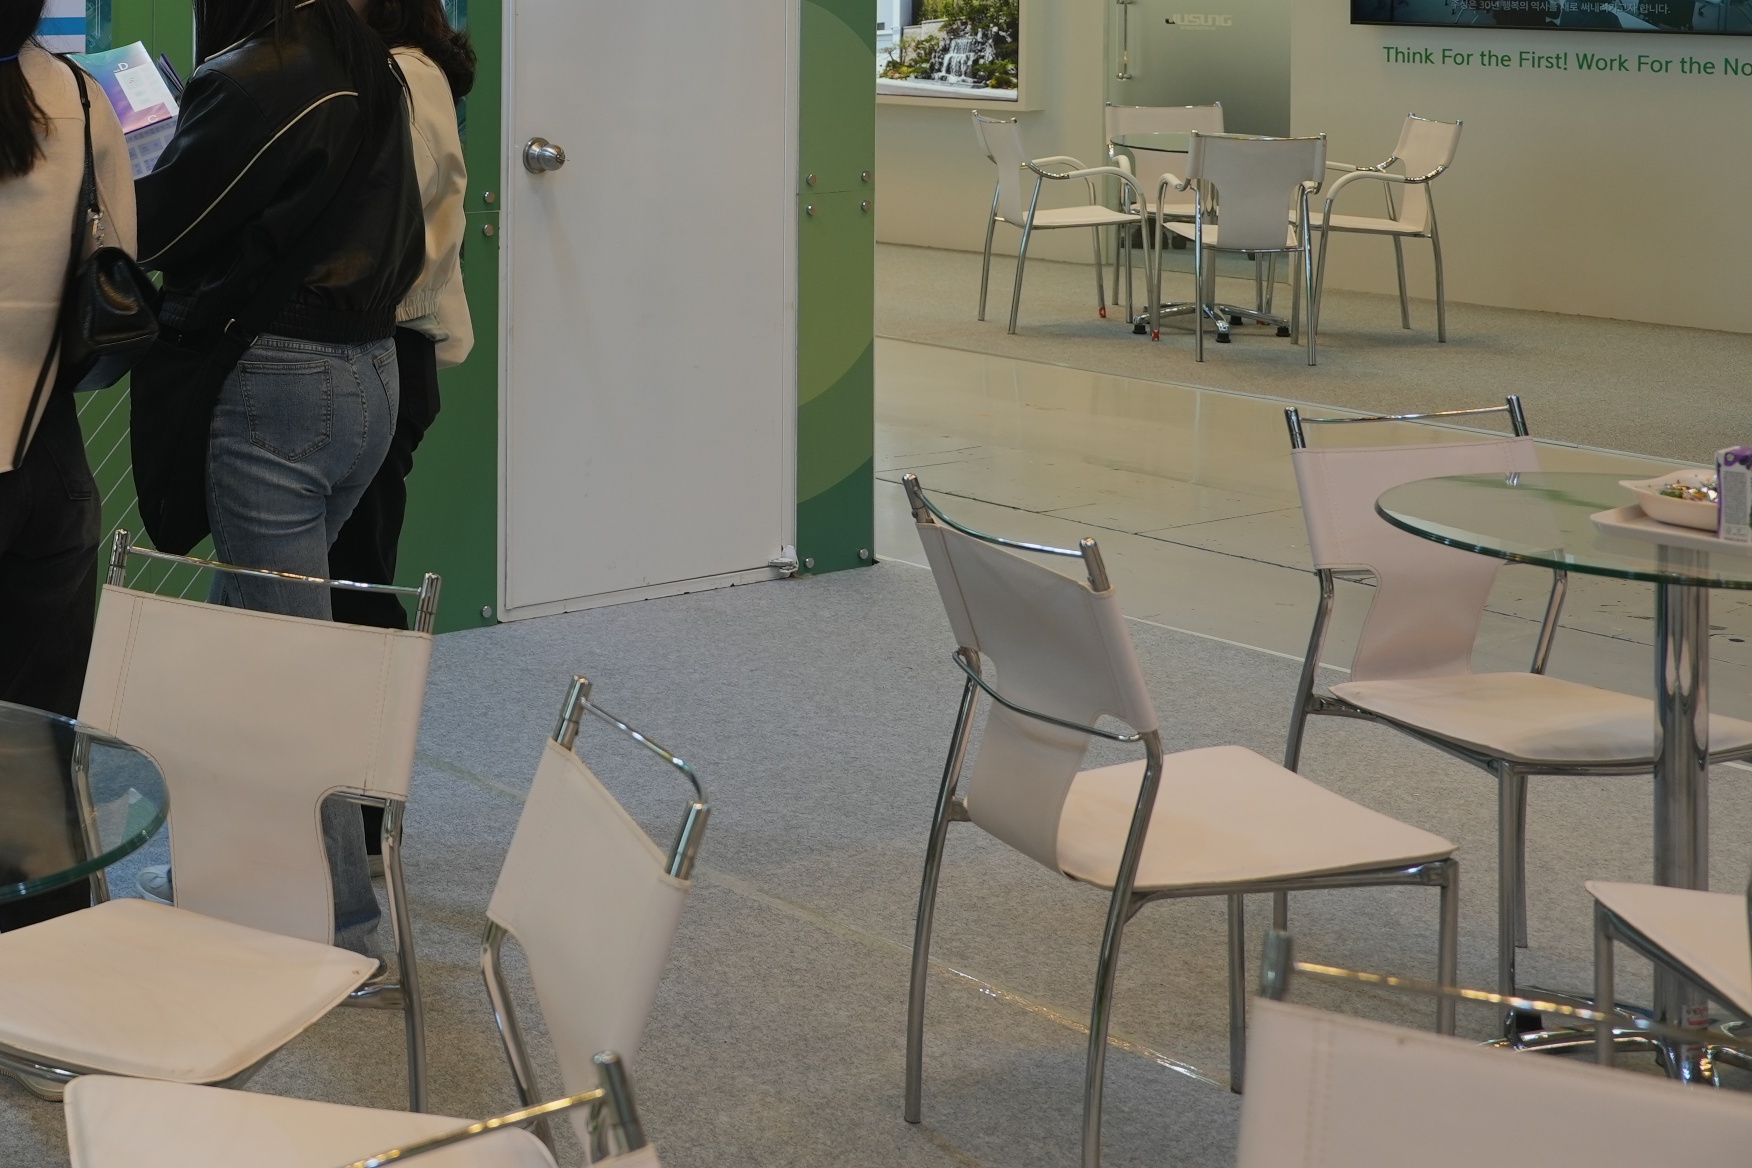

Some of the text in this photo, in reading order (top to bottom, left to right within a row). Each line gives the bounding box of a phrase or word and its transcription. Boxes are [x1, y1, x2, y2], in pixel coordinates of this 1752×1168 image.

[1451, 0, 1476, 10] 주성은
[1479, 0, 1500, 10] 30년
[1502, 0, 1528, 11] 행복의
[1383, 47, 1435, 65] Think
[1442, 49, 1473, 66] For
[1480, 50, 1512, 67] the
[1519, 52, 1568, 71] First!
[1576, 53, 1630, 72] Work
[1637, 55, 1673, 74] For
[1680, 57, 1716, 75] the
